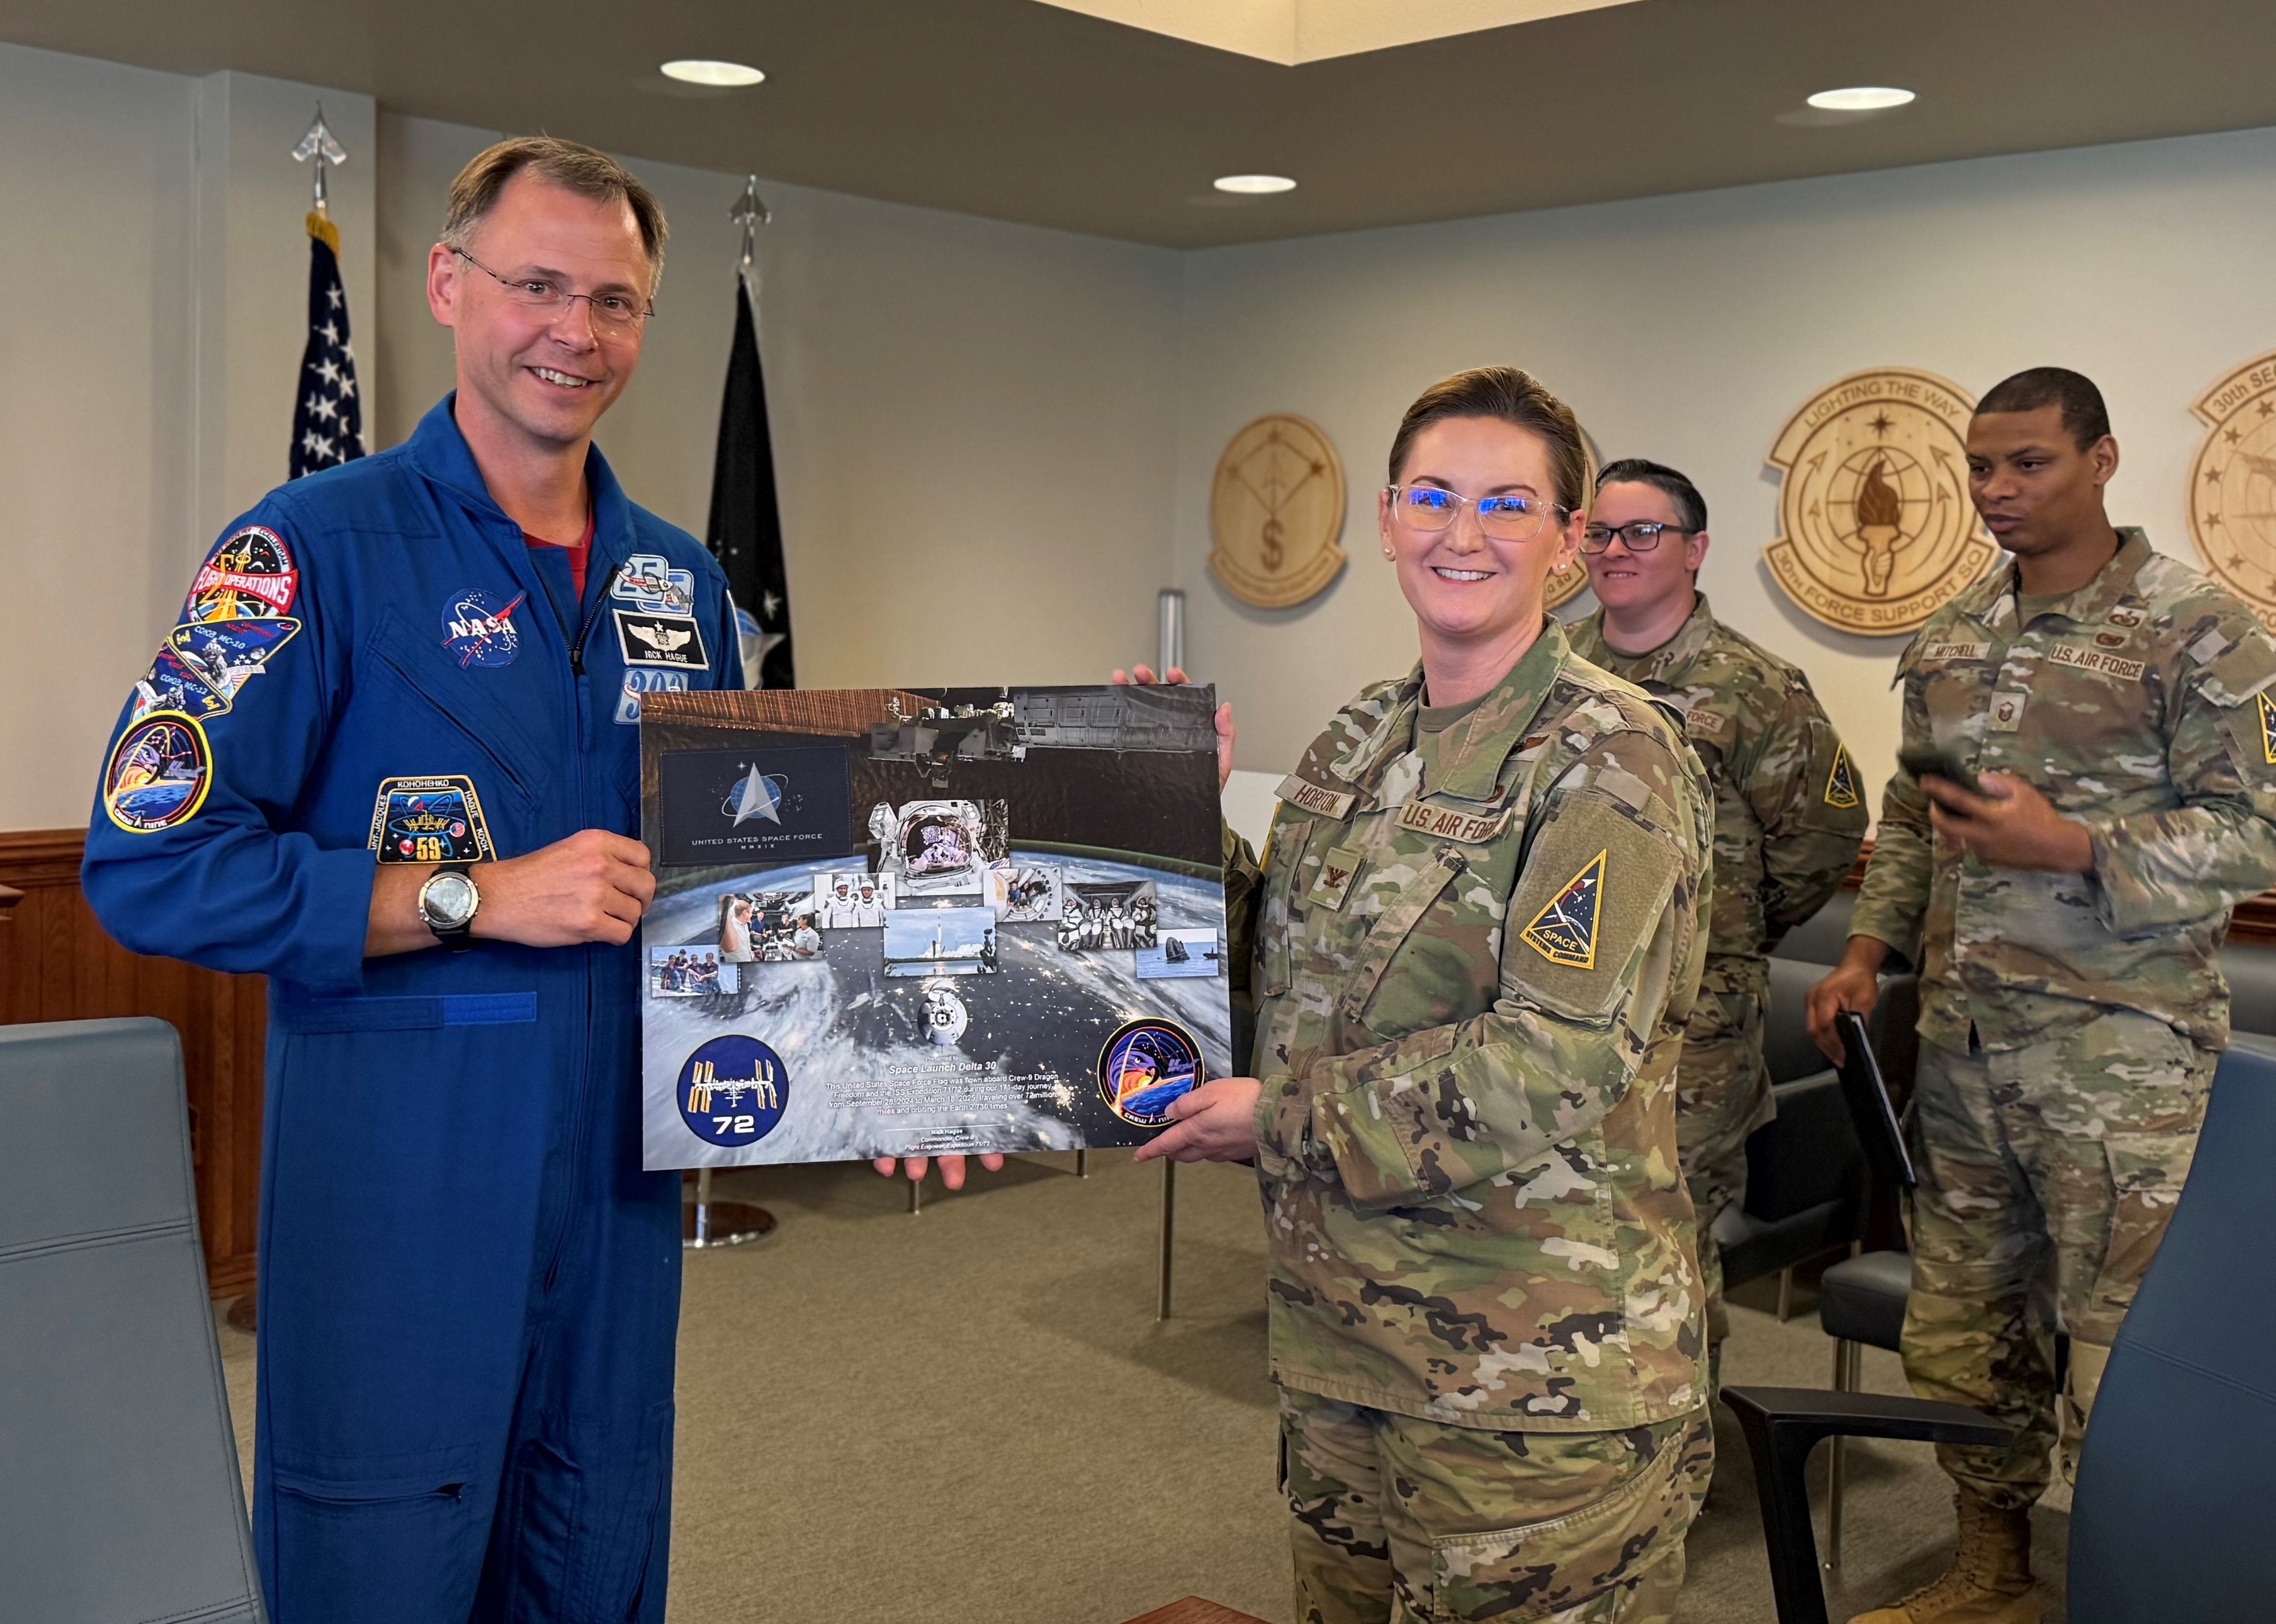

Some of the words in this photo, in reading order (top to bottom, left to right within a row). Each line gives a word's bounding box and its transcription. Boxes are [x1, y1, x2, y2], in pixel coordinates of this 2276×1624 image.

[2213, 384, 2250, 413] 30th
[2250, 364, 2276, 388] SE
[1804, 381, 1881, 429] LIGHTING
[1886, 381, 1920, 399] THE
[1923, 390, 1961, 418] WAY
[192, 567, 226, 592] FLIGHT
[224, 574, 292, 605] OPERATIONS
[1776, 550, 1804, 590] 30TH
[1804, 586, 1866, 620] FORCE
[1870, 577, 1959, 623] SUPPORT
[1958, 548, 1985, 580] SQ
[448, 617, 518, 639] NASA
[645, 650, 662, 659] NICK
[665, 652, 688, 662] HAGUE
[1934, 644, 1977, 657] MITCHELL
[2051, 646, 2073, 663] U.S.
[2074, 650, 2100, 667] AIR
[2100, 656, 2143, 678] FORCE
[1687, 710, 1719, 728] FORCE
[464, 790, 479, 819] HAGUE
[1294, 784, 1341, 812] HORTON
[1402, 803, 1432, 828] U.S.
[1430, 812, 1464, 836] AIR
[416, 836, 441, 860] 59
[476, 827, 489, 851] KOCH
[1543, 929, 1579, 951] SPACE
[889, 1065, 919, 1076] Space
[921, 1063, 956, 1073] Launch
[958, 1062, 983, 1071] Delta
[985, 1061, 996, 1070] 30
[1034, 1073, 1059, 1081] Dragon
[846, 1099, 883, 1108] September
[712, 1115, 755, 1135] 72
[1124, 1112, 1147, 1124] CREW
